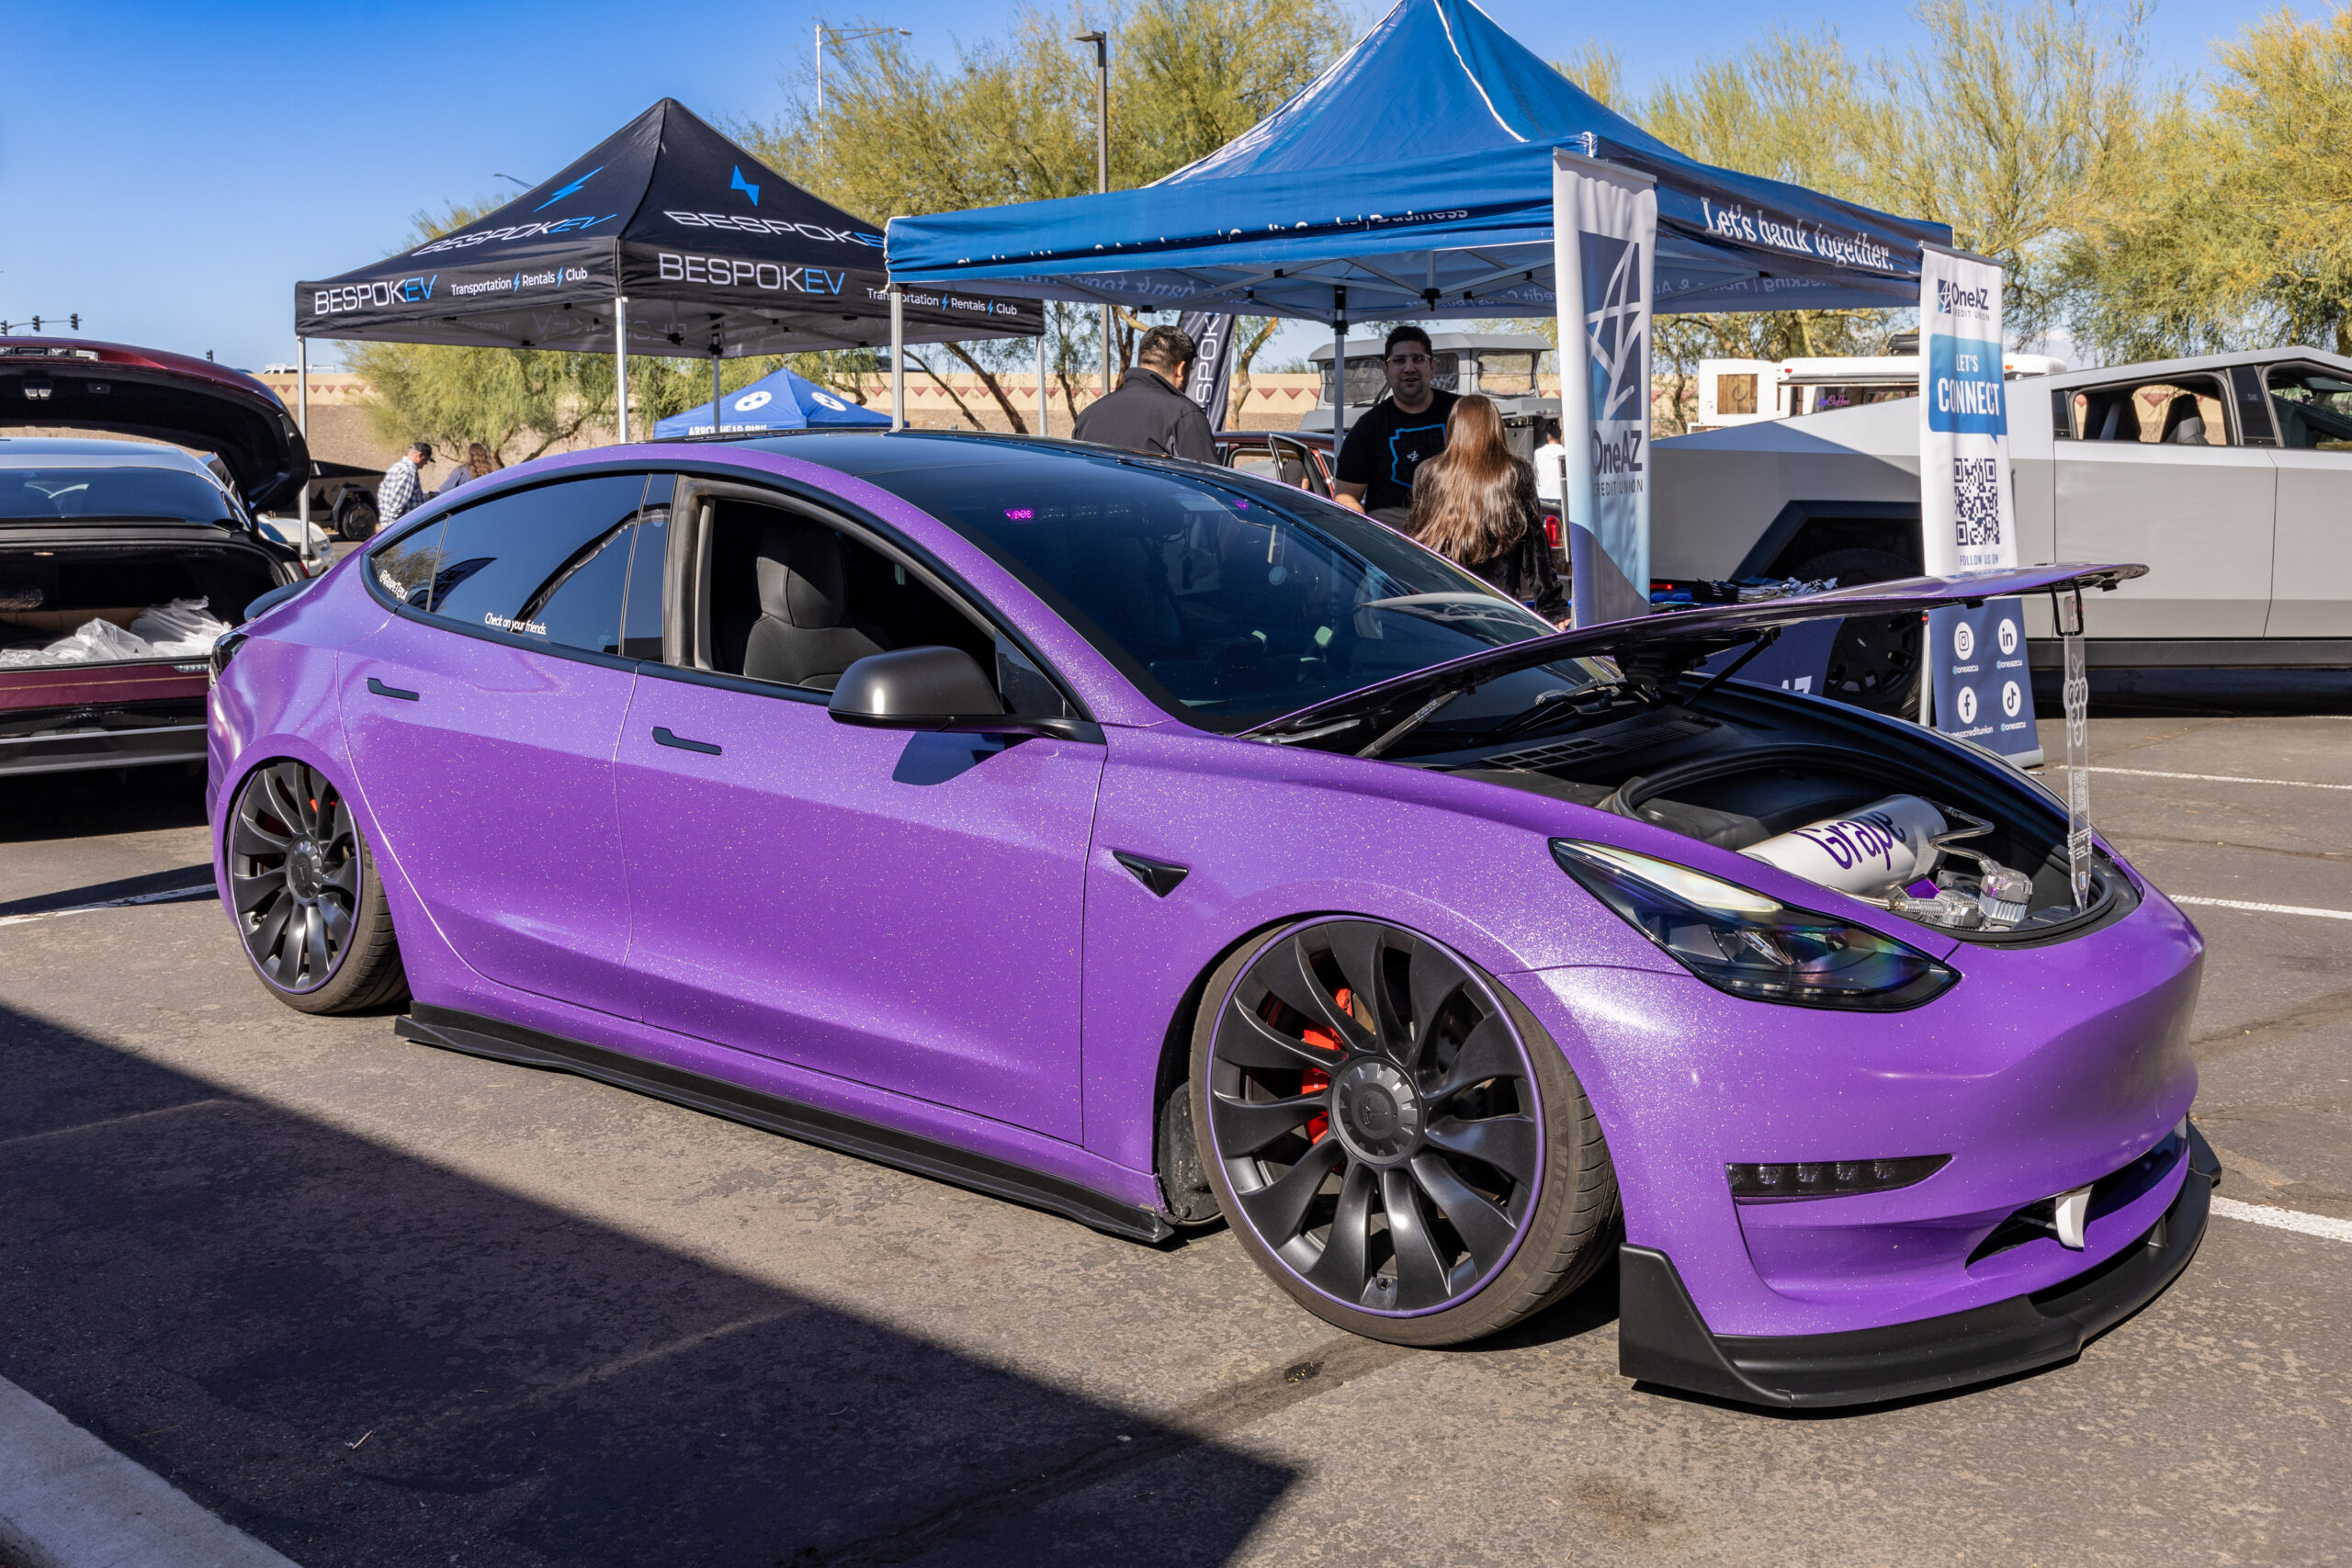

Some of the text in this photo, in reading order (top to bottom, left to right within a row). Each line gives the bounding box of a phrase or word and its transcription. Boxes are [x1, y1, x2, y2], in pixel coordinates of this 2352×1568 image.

[412, 213, 617, 257] BESPOKEV
[663, 210, 885, 248] BESPOKE
[1701, 197, 1894, 271] Let's bank together.
[451, 266, 588, 297] Transportation Rentals Club
[659, 252, 845, 296] BESPOKEV
[314, 274, 437, 315] BESPOKEV
[866, 288, 1017, 316] Tranortation Rentals Club
[1951, 281, 1989, 311] OneAZ
[1952, 308, 1991, 322] CREDIT UNION
[1195, 313, 1221, 406] SPOK
[1955, 353, 1979, 373] LET'S
[1937, 377, 2000, 416] CONNECT
[1590, 429, 1643, 476] OneAZ
[1592, 478, 1644, 498] CREDIT UNION
[1960, 553, 1999, 567] FOLLOW US ON
[484, 612, 503, 628] Check
[503, 618, 511, 628] on
[509, 619, 526, 632] your
[1952, 664, 1979, 675] @oneazcu
[1996, 660, 2023, 670] @oneazcu
[2000, 720, 2027, 732] @oneazcu
[1789, 810, 1907, 872] Grape
